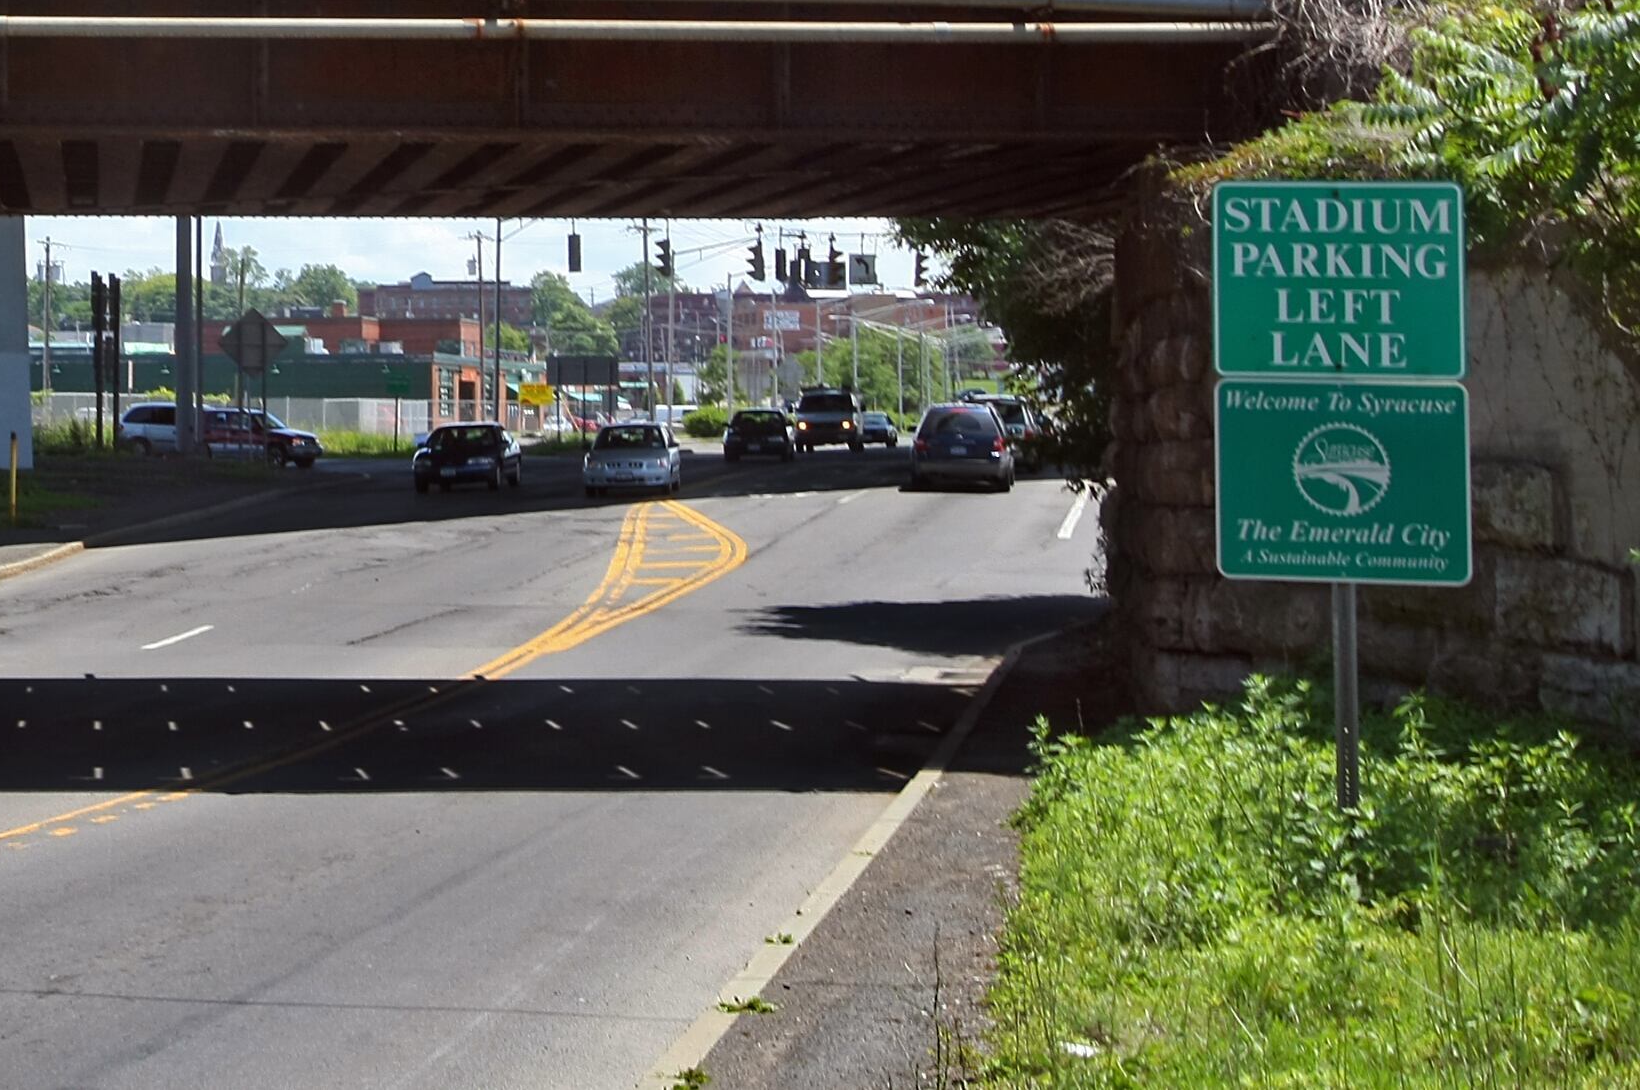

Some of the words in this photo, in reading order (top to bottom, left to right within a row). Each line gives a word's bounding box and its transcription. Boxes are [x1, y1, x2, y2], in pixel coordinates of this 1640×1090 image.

[1224, 197, 1453, 235] STADIUM
[1230, 242, 1448, 279] PARKING
[1274, 288, 1401, 325] LEFT
[1269, 331, 1408, 368] LANE
[1226, 390, 1320, 411] Welcome
[1328, 391, 1352, 412] To
[1357, 392, 1457, 417] Syracuse
[1237, 518, 1282, 542] The
[1290, 520, 1395, 545] Emerald
[1401, 523, 1451, 552] City
[1240, 548, 1254, 563] A
[1257, 548, 1351, 567] Sustainable
[1356, 553, 1449, 573] Community
